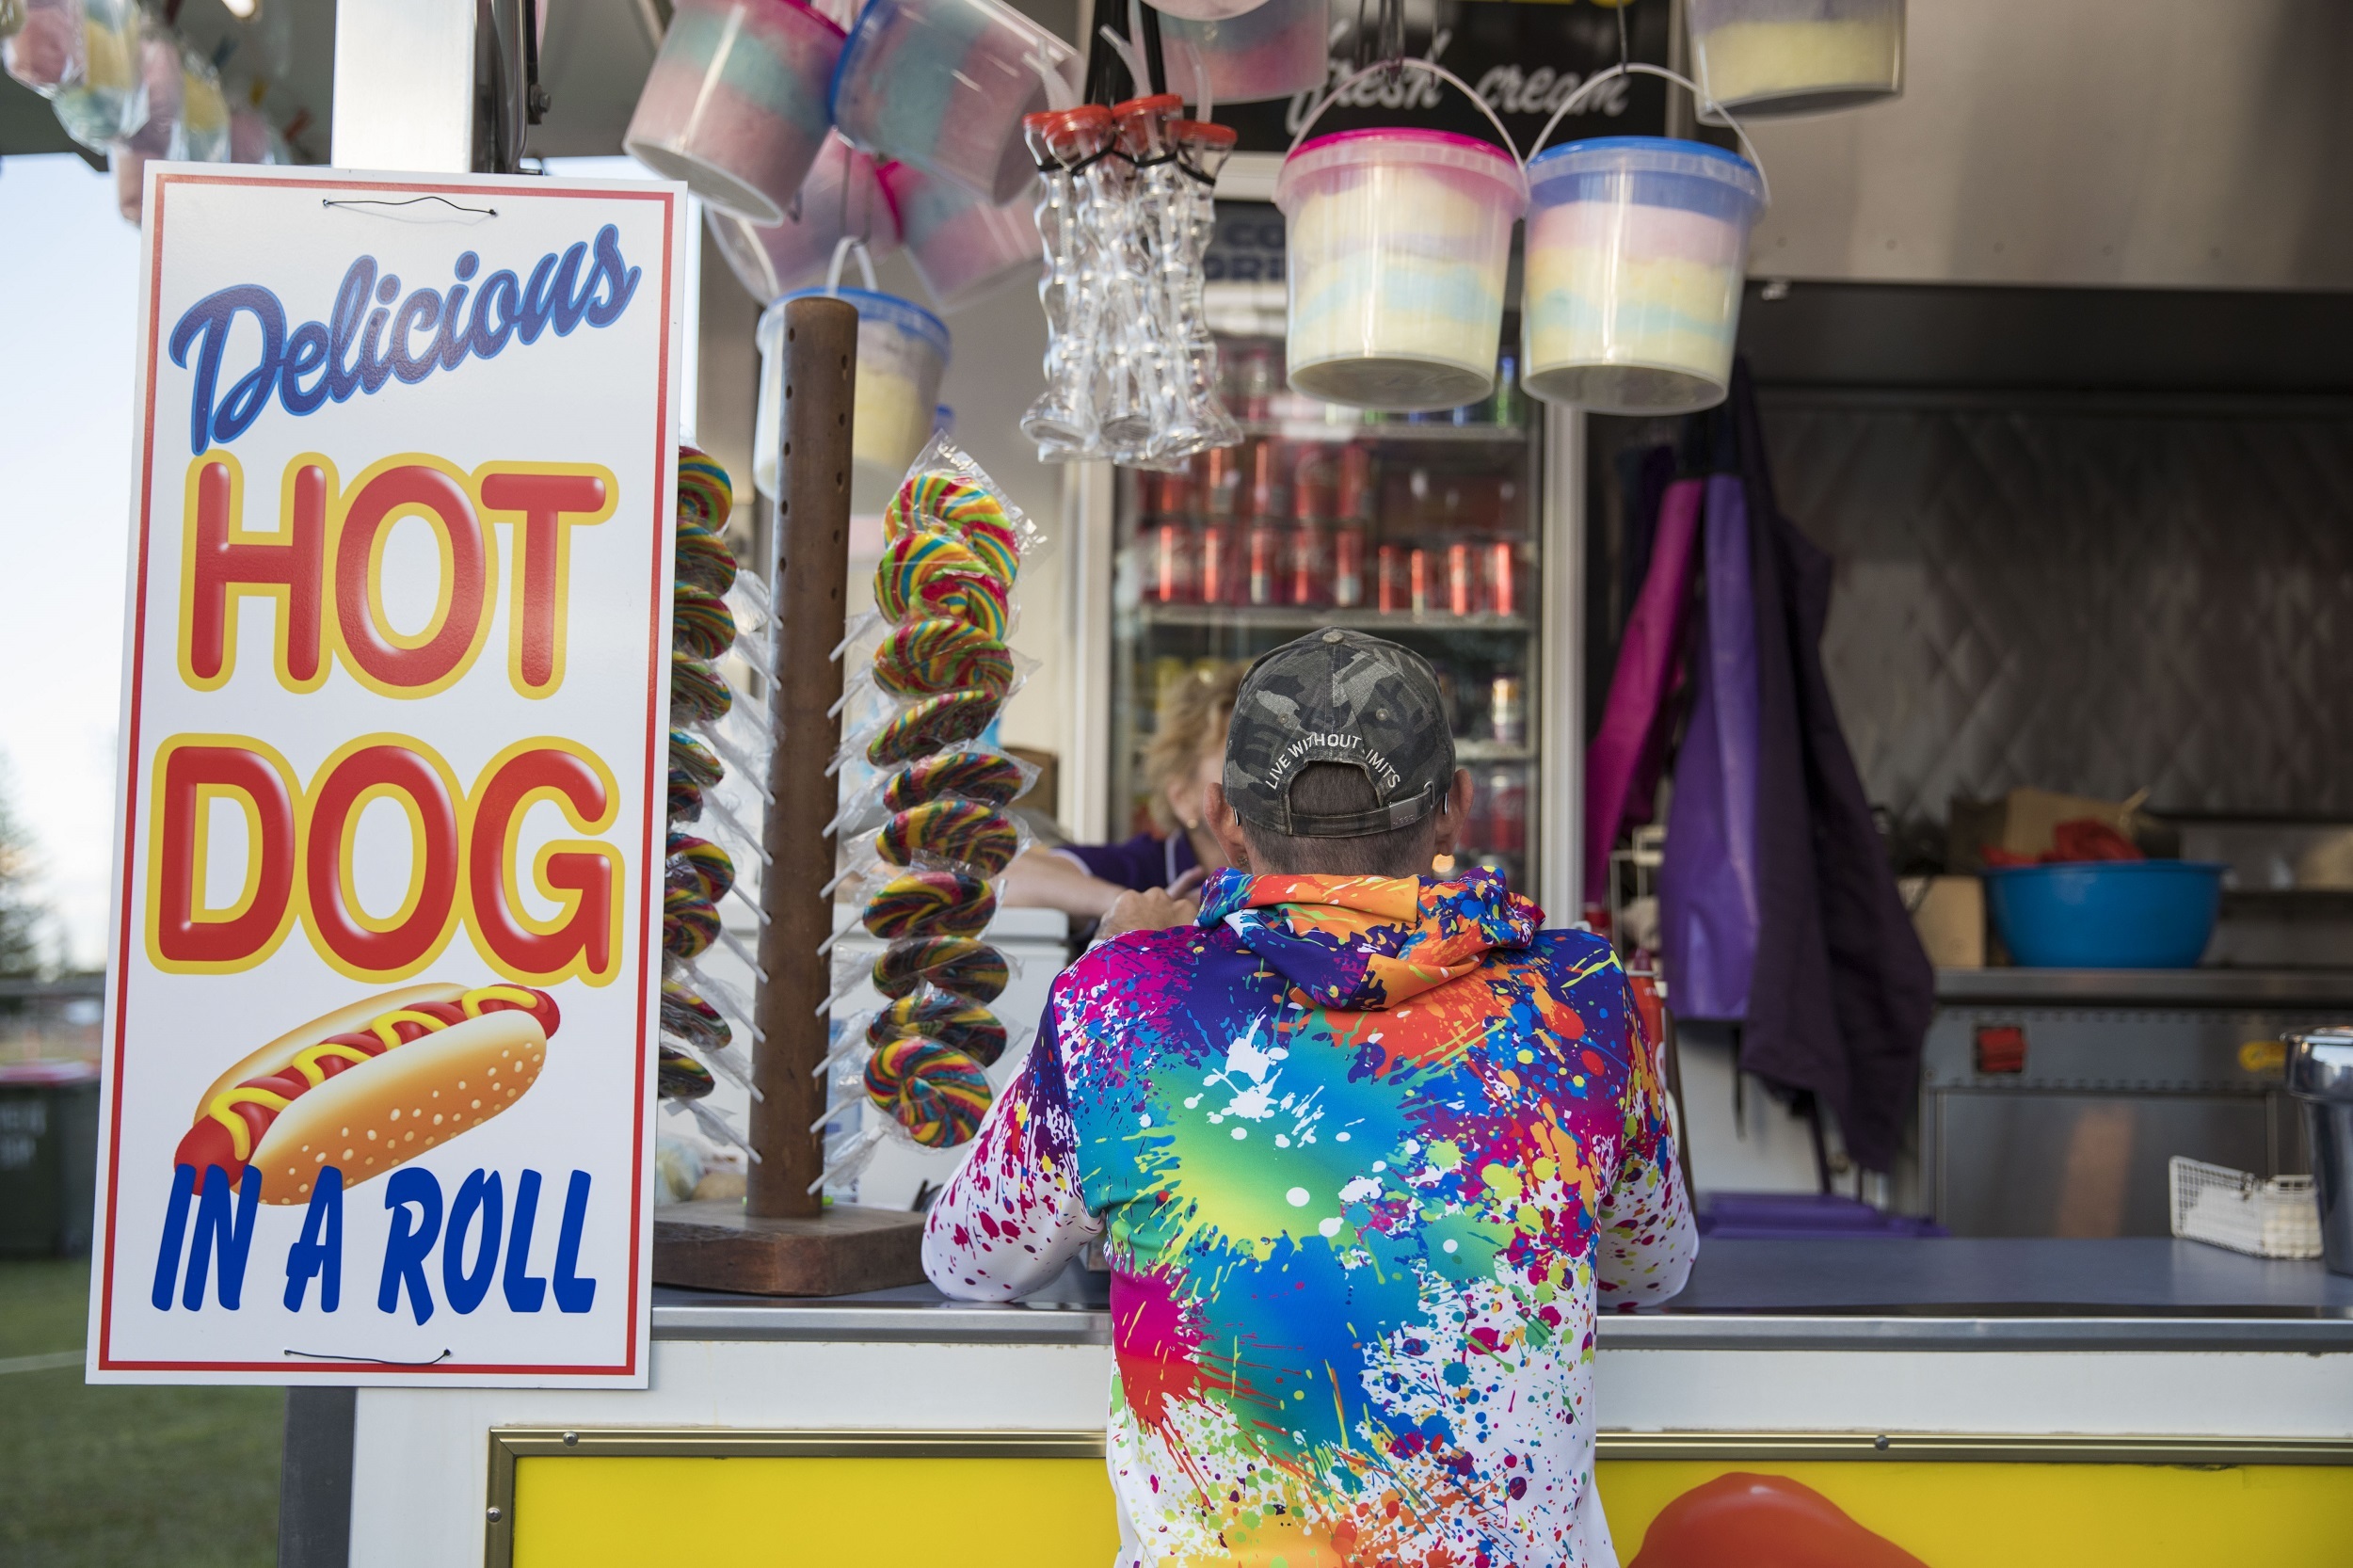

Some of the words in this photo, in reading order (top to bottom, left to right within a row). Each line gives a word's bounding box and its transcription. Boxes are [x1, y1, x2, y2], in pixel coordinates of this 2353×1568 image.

[1471, 63, 1631, 118] cream
[168, 224, 642, 456] Delicious
[177, 449, 619, 700] HOT
[145, 732, 625, 987] DOG
[1265, 754, 1291, 790] LIVE
[1288, 732, 1362, 758] WITHOUT
[1362, 748, 1401, 789] IMITS
[152, 1163, 263, 1311] IN
[283, 1165, 344, 1313] A
[377, 1167, 597, 1326] ROLL
